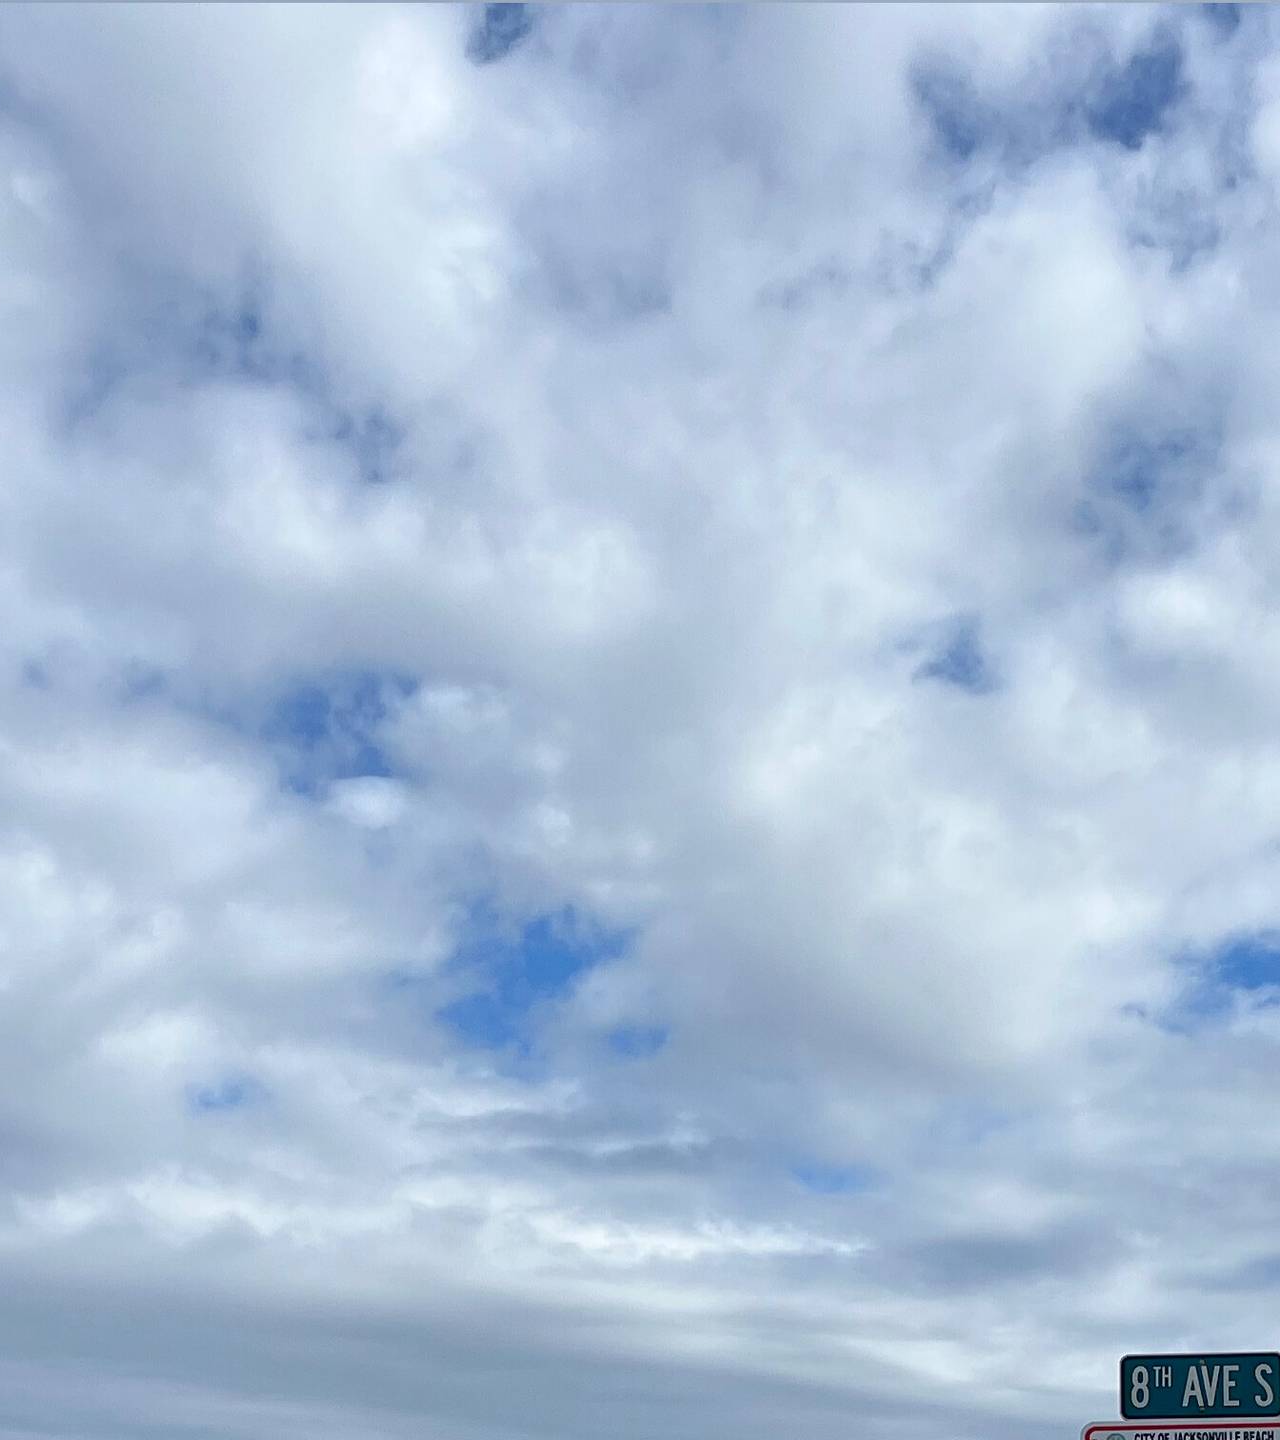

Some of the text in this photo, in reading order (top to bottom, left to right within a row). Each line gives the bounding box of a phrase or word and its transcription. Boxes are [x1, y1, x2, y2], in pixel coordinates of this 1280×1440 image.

[1130, 1363, 1274, 1409] 8TH AVE S
